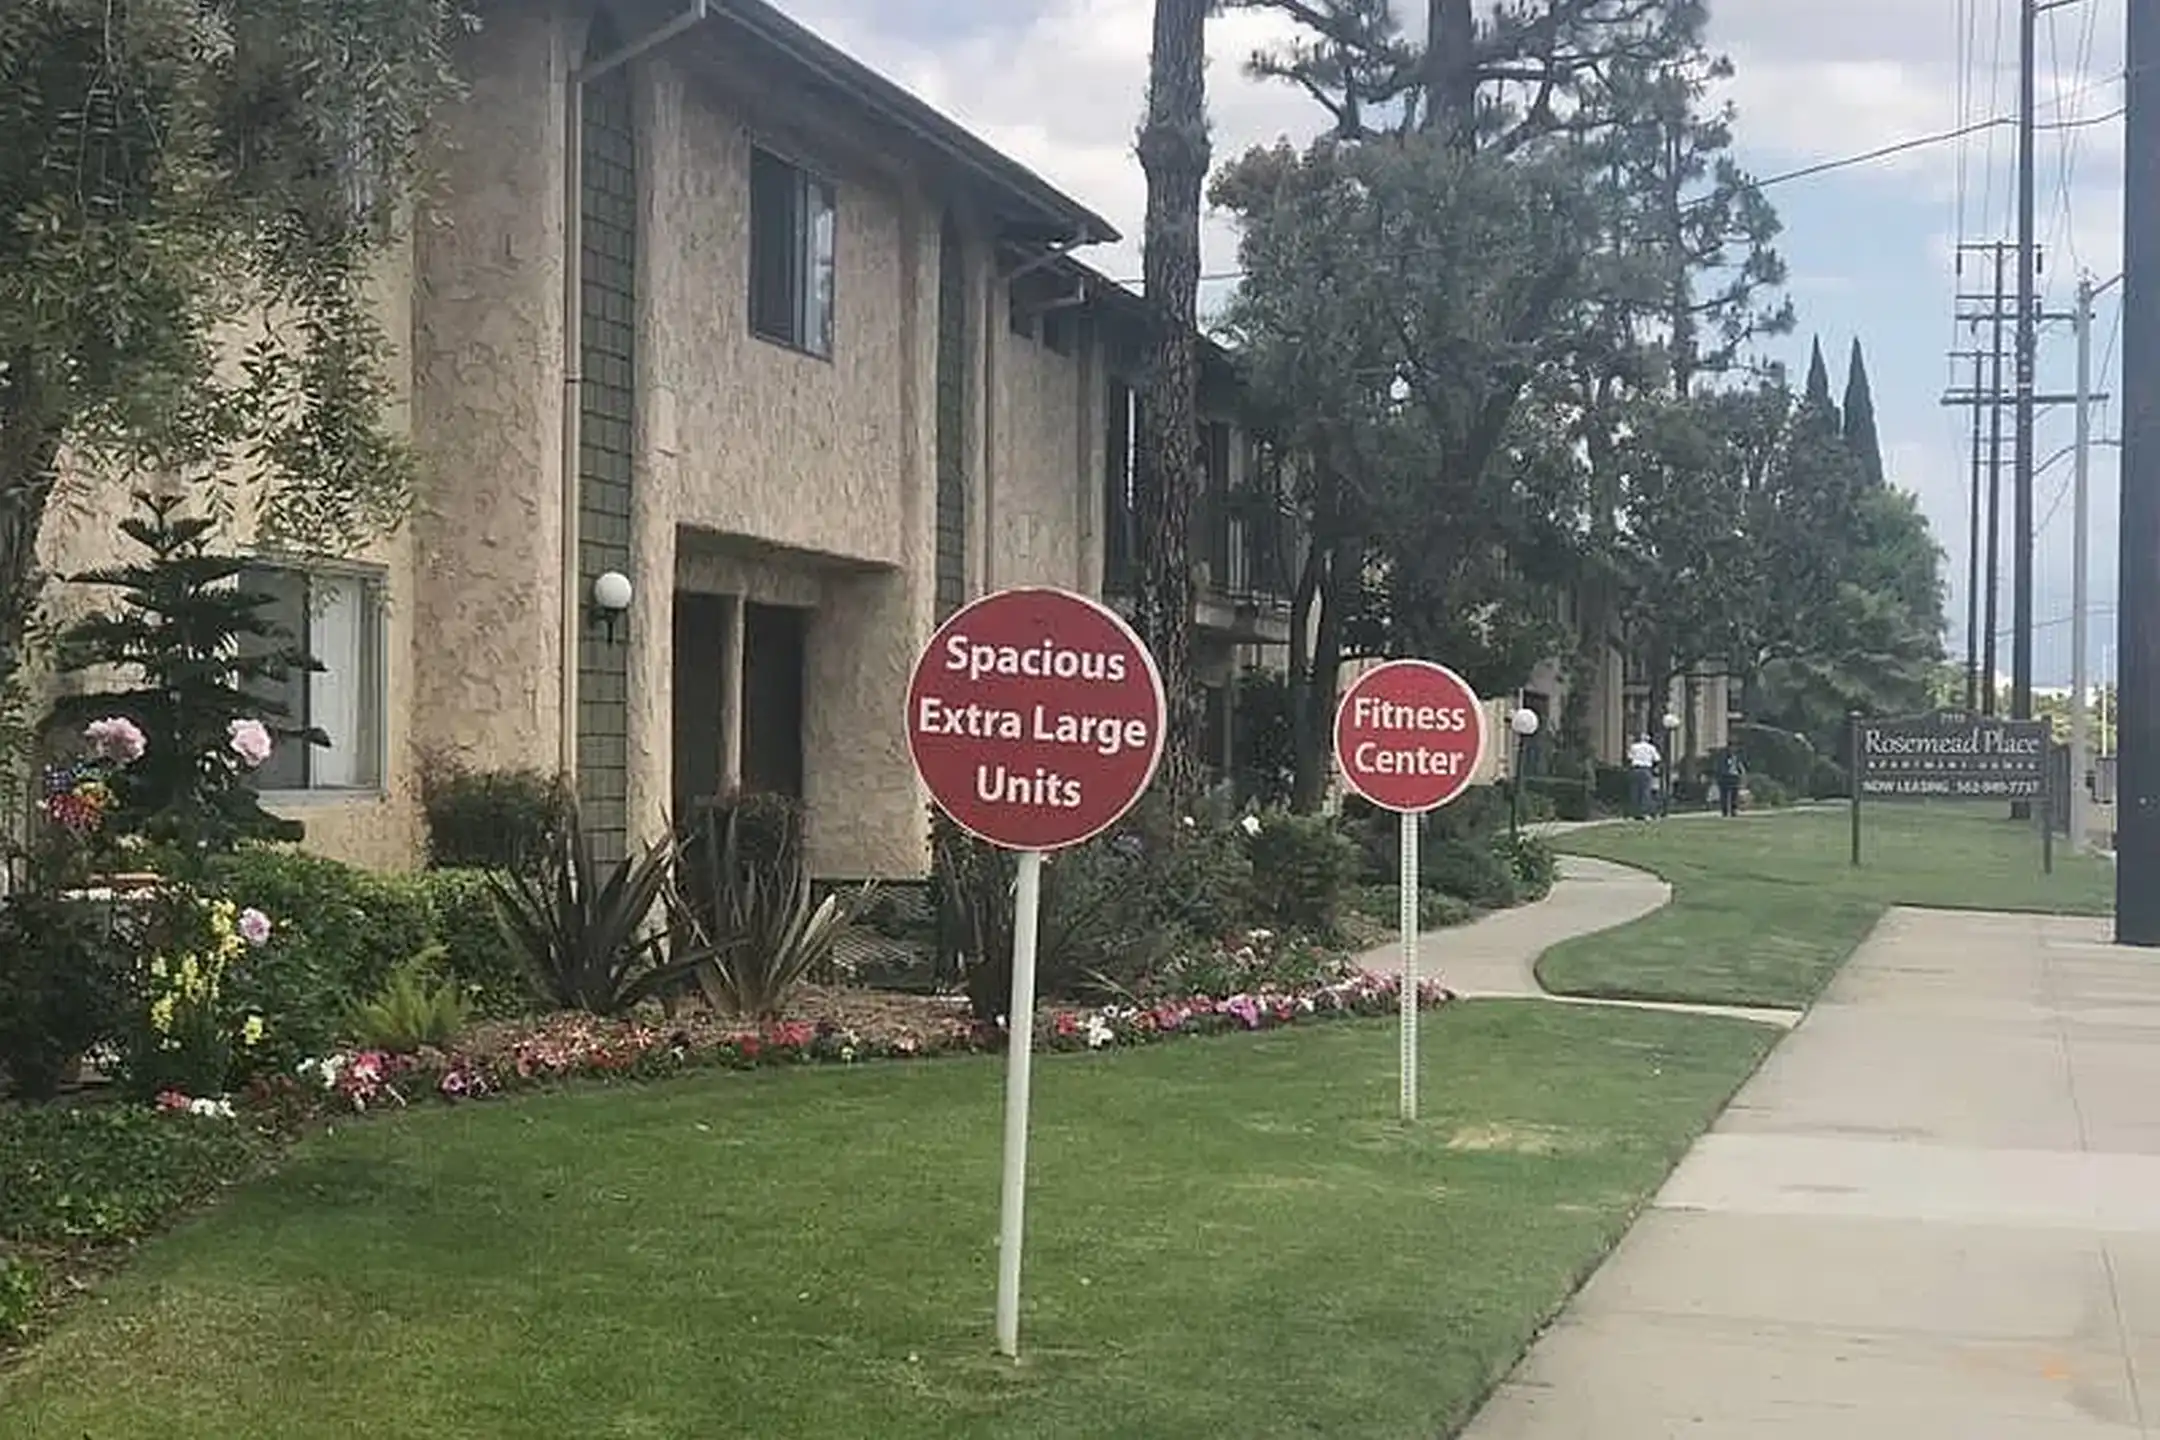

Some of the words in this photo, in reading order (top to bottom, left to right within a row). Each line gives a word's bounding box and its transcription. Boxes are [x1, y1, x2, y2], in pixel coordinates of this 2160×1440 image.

[945, 635, 1126, 681] Spacious
[919, 697, 1021, 740] Extra
[1034, 705, 1148, 754] Large
[1354, 697, 1467, 731] Fitness
[1865, 726, 1980, 754] Rosemead
[1984, 728, 2039, 754] Place
[1355, 741, 1465, 774] Center
[977, 765, 1082, 807] Units
[1862, 781, 1894, 793] NOW
